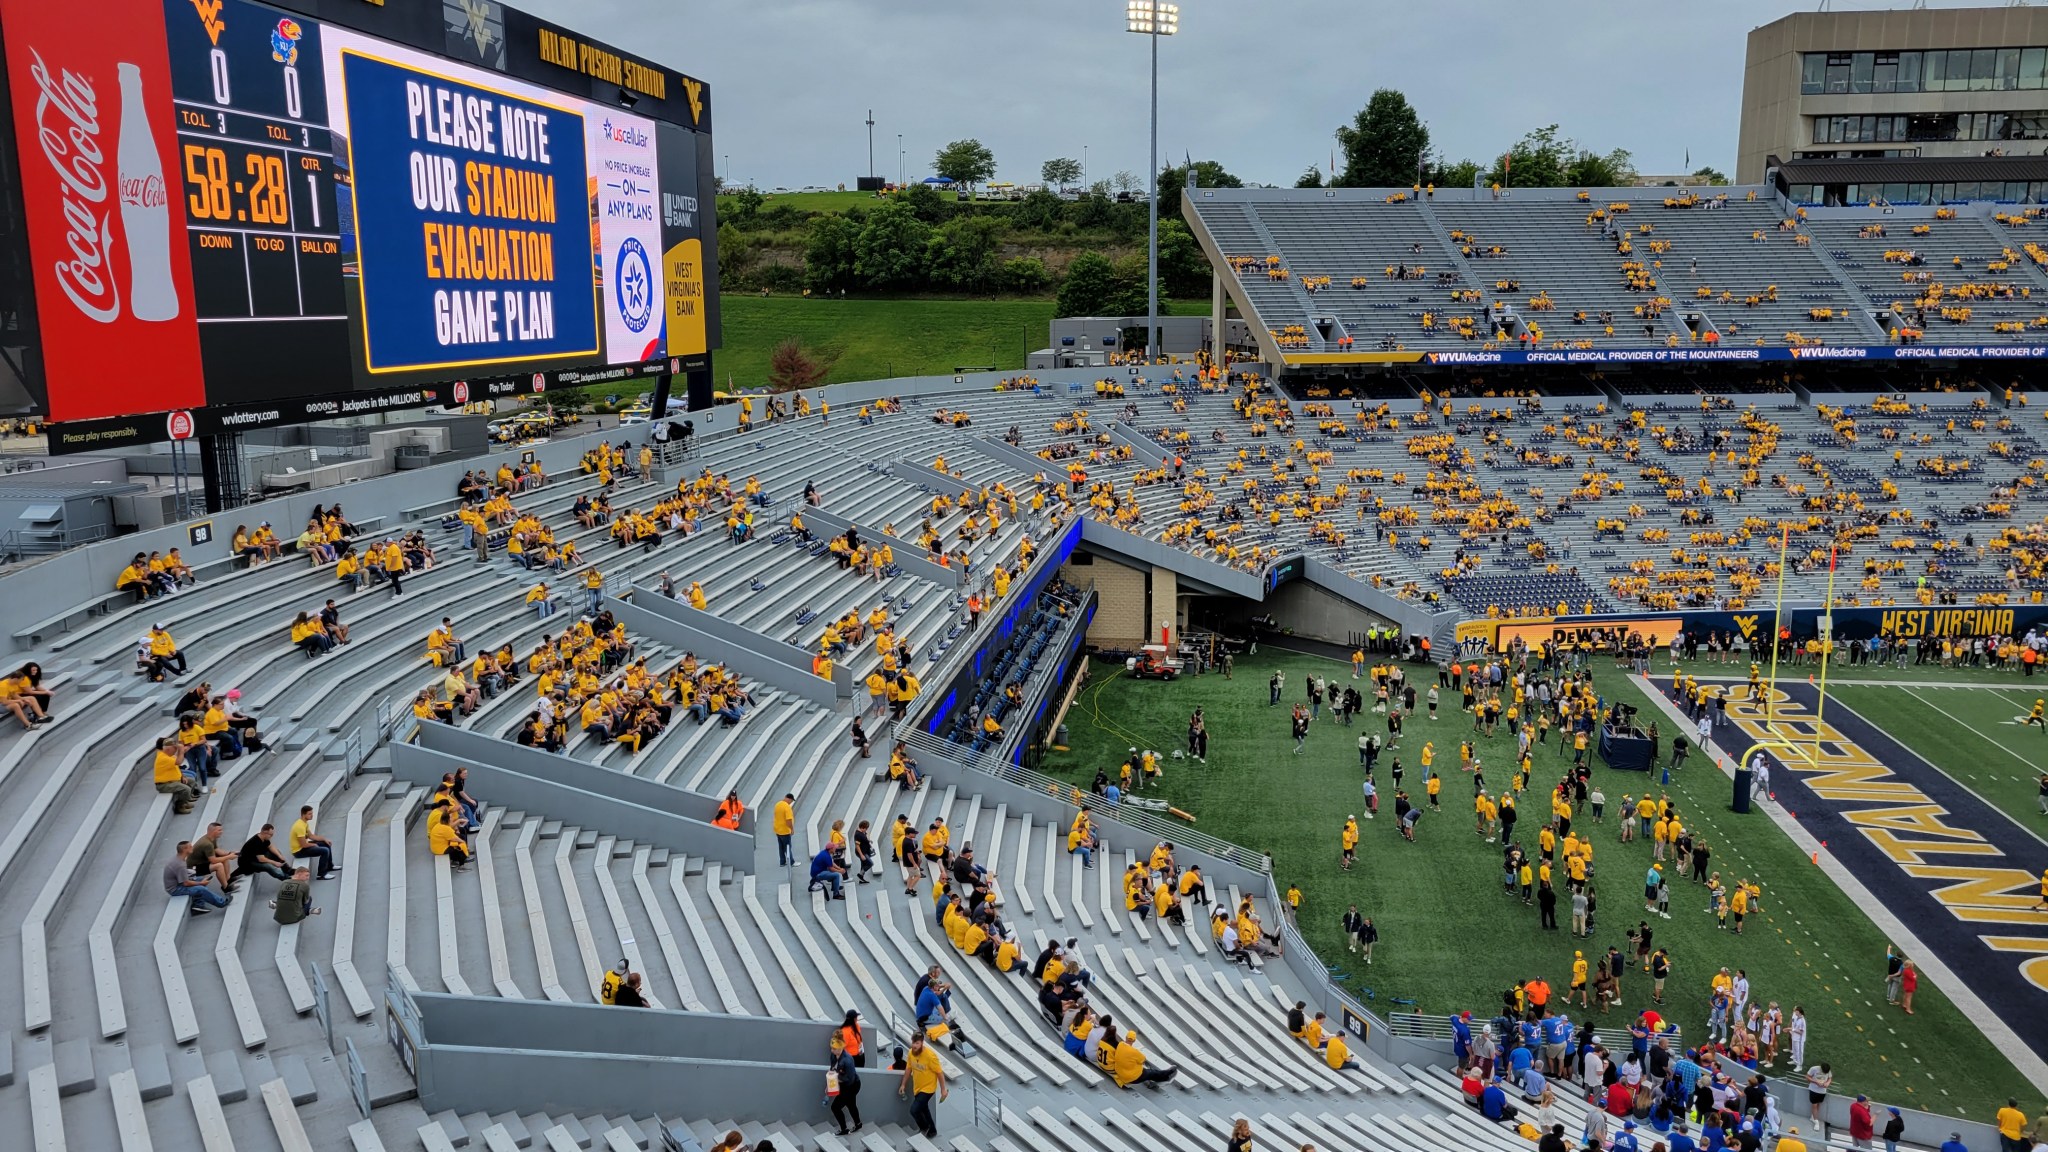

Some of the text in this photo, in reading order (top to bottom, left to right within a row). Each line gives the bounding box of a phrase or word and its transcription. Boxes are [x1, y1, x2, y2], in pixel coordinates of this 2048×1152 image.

[538, 28, 665, 100] MILAN PUSKAR STADIUM
[211, 49, 229, 105] 0
[284, 66, 301, 117] 0
[181, 111, 226, 134] T.O.L. 3
[407, 81, 550, 164] PLEASE NOTE
[267, 126, 309, 147] T.O.L. 3
[613, 127, 647, 147] uscellular
[301, 157, 321, 172] QTR.
[605, 159, 650, 177] NO PRICE INCREASE
[184, 144, 287, 224] 58:28
[410, 152, 556, 223] OUR STADIUM
[622, 179, 636, 196] ON
[308, 175, 320, 227] 1
[672, 195, 697, 212] UNITED
[608, 200, 652, 221] ANY PLANS
[673, 213, 692, 228] BANK
[200, 234, 232, 249] DOWN
[255, 237, 284, 252] TO GO
[301, 240, 337, 254] BALL ON
[624, 240, 642, 255] PRICE
[424, 223, 553, 281] EVACUATION
[674, 262, 692, 278] WEST
[667, 281, 701, 297] VIRGINIA'S
[677, 300, 695, 316] BANK
[435, 290, 553, 346] GAME PLAN
[622, 305, 650, 331] PROTECTED
[1439, 352, 1501, 361] WVUMedicine
[1527, 350, 1759, 361] OFFICIAL MEDICAL PROVIDER OF THE MOUNTAINEERS
[1801, 348, 1866, 357] WVUMedicine
[1895, 349, 1936, 357] OFFICIAL
[1938, 348, 1980, 356] MEDICAL
[1982, 348, 2030, 356] PROVIDER
[489, 382, 514, 393] Play Today!
[342, 400, 370, 412] Jackpots
[371, 398, 377, 408] in
[378, 396, 388, 407] the
[389, 392, 421, 405] MILLIONS!
[223, 410, 279, 425] wvlottery.com
[63, 428, 138, 443] Please play responsibly.
[195, 527, 206, 541] 98
[1881, 610, 1929, 637] WEST
[1349, 1015, 1361, 1035] 99
[1554, 1024, 1564, 1036] 47
